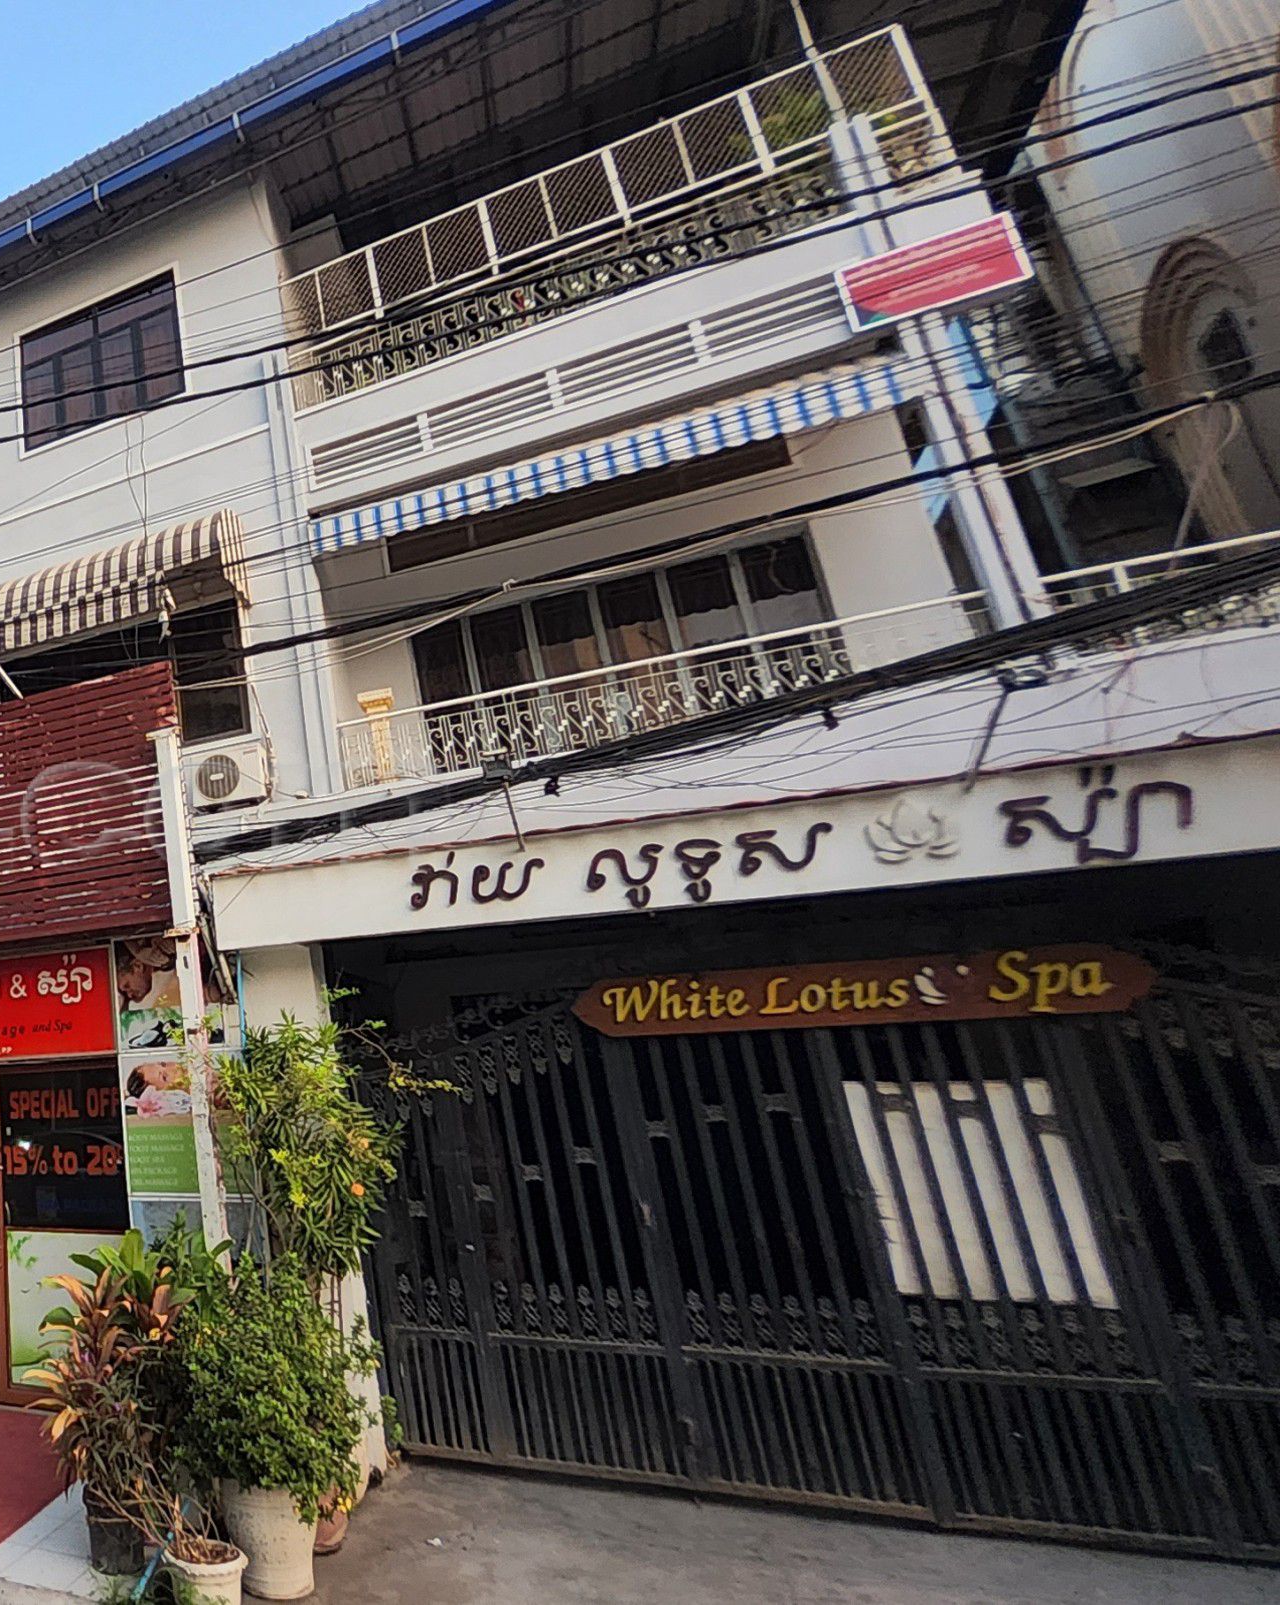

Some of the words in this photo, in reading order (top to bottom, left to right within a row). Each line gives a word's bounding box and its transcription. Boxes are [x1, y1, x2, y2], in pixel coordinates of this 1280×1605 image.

[9, 974, 28, 999] &
[603, 979, 751, 1023] White
[758, 976, 911, 1017] Lotus
[988, 949, 1112, 1014] Spa
[32, 1019, 52, 1033] and
[53, 1018, 73, 1034] Spa
[9, 1087, 80, 1119] SPECIAL
[3, 1144, 49, 1176] 15%
[52, 1144, 79, 1176] to
[86, 1144, 123, 1177] 20
